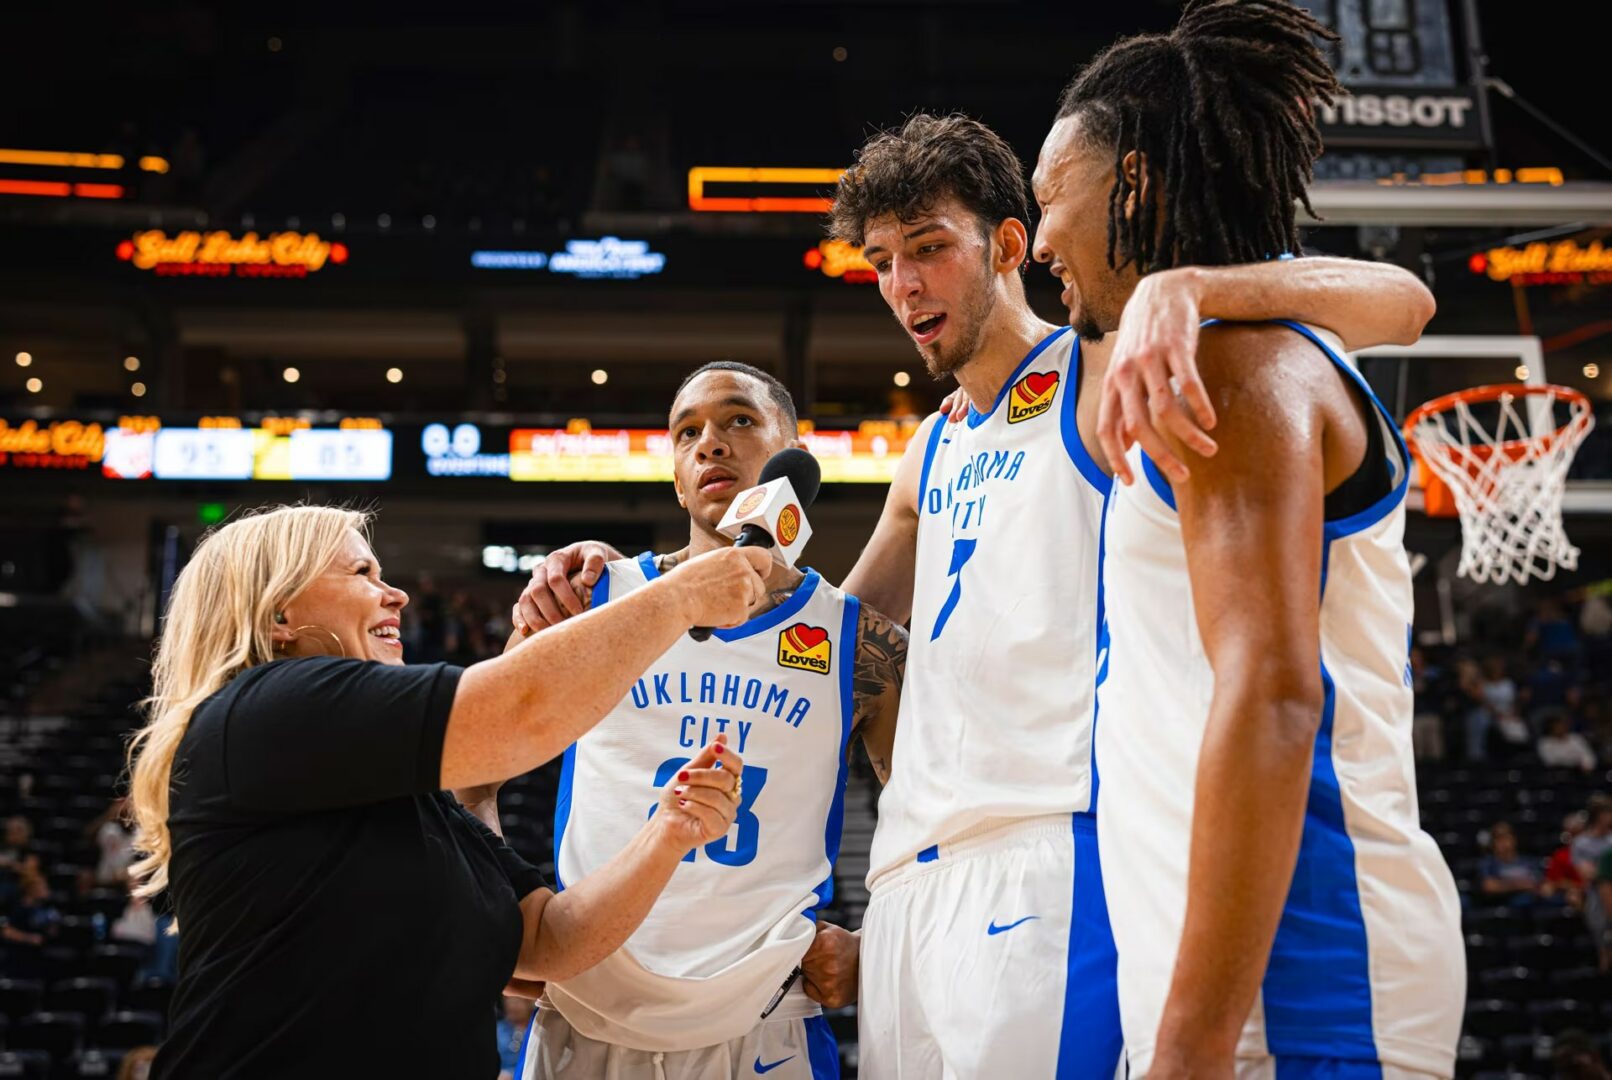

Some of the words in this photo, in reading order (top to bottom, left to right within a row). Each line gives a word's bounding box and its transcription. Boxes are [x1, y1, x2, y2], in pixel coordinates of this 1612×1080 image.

[1314, 94, 1472, 127] TISSOT
[0, 418, 50, 453] ake
[929, 451, 1026, 514] OKAHOMA
[952, 494, 987, 538] ITY
[930, 538, 977, 642] 7
[631, 672, 811, 728] OKLAHOMA
[679, 715, 752, 753] CITY
